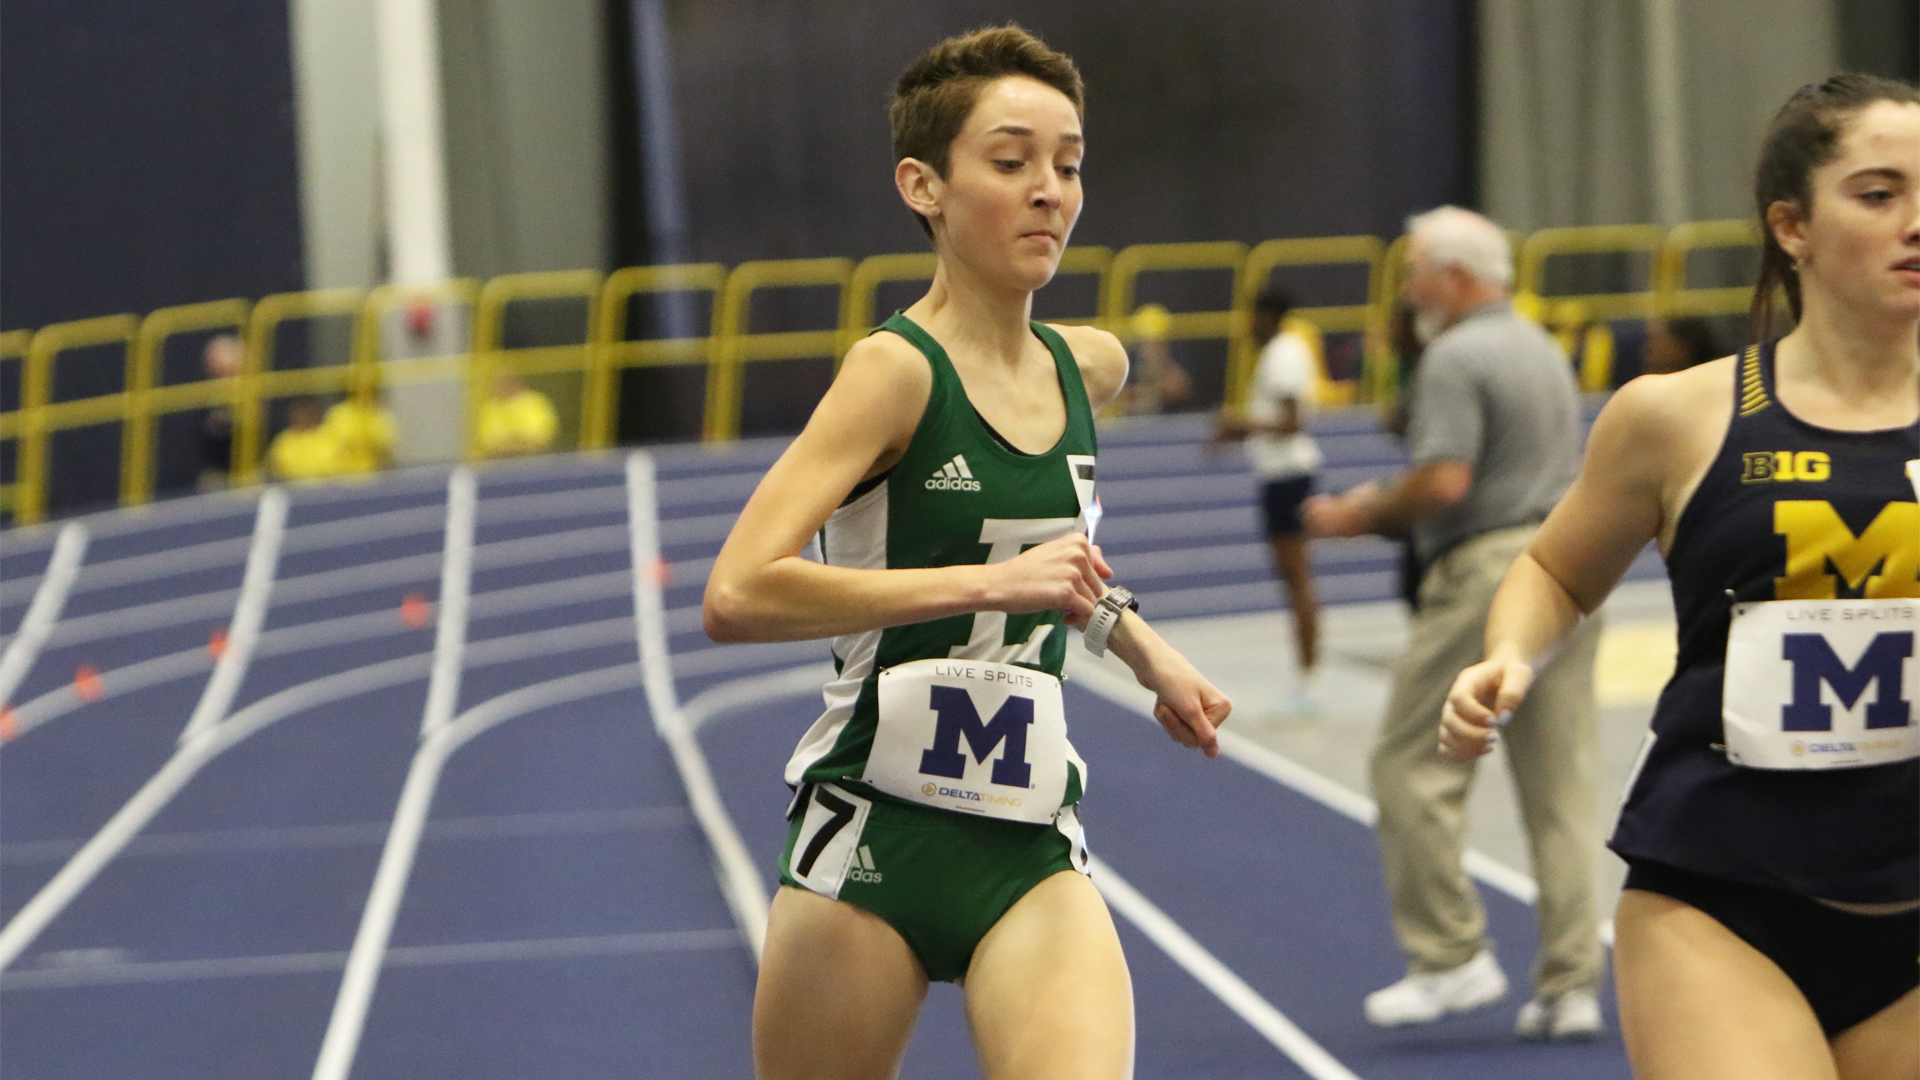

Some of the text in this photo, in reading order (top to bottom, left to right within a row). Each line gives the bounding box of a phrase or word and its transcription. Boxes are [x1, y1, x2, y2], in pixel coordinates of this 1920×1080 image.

[925, 477, 981, 492] adidas
[1773, 499, 1920, 600] M
[1786, 606, 1913, 621] LIVE SPLITS
[935, 665, 1033, 688] LIVE SPLITS
[1780, 630, 1914, 732] M
[918, 684, 1035, 788] M
[796, 784, 857, 879] 7
[847, 866, 882, 883] idas
